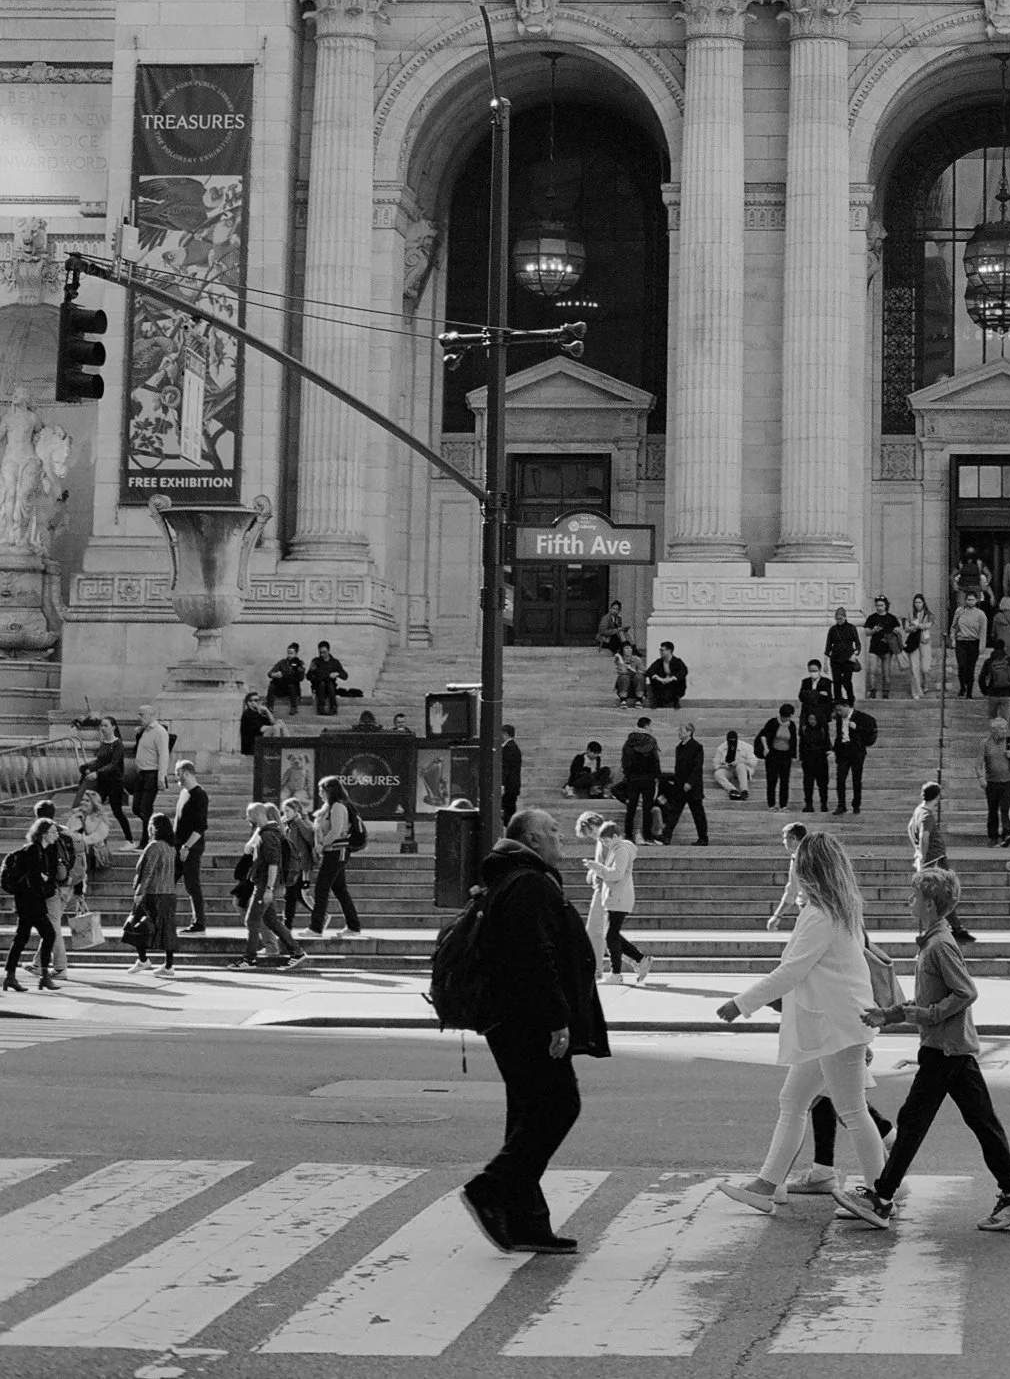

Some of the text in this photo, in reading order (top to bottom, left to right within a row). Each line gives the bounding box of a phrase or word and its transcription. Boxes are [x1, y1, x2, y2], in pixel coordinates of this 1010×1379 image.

[194, 80, 218, 91] PUBLIC
[0, 112, 111, 127] YET EVER NEW
[142, 113, 245, 130] TREASURES
[50, 134, 99, 148] VOICE
[60, 155, 107, 169] WORD
[128, 476, 233, 488] FREE EXHIBITION
[536, 533, 632, 555] Fifth Ave
